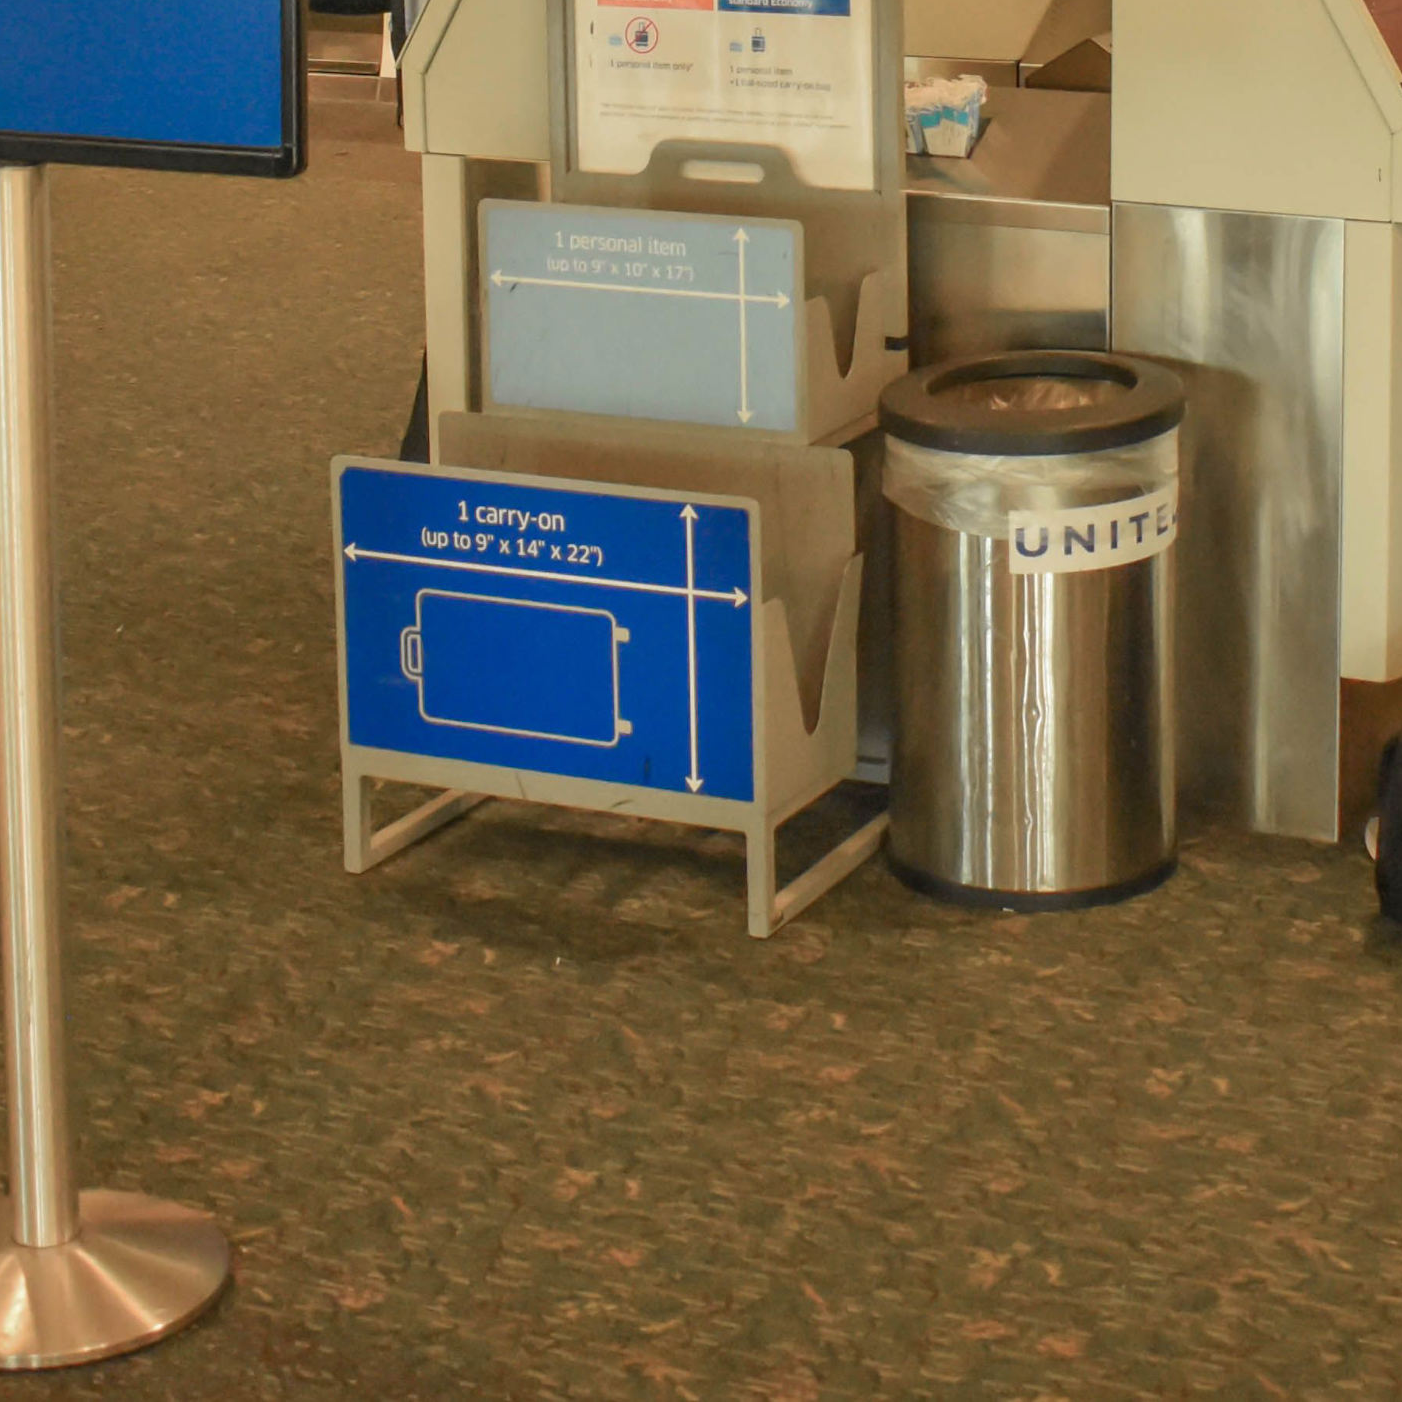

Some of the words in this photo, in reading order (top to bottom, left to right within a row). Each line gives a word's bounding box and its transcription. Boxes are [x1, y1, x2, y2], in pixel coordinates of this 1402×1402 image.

[555, 230, 564, 248] 1
[570, 234, 642, 253] personal
[648, 237, 687, 256] item
[547, 255, 569, 272] (up
[573, 257, 587, 273] to
[610, 264, 619, 275] x
[625, 262, 648, 277] 10"
[652, 267, 661, 278] x
[458, 500, 469, 522] 1
[475, 506, 565, 532] carry-on
[1015, 503, 1176, 557] UNITE
[421, 526, 448, 549] (up
[453, 531, 471, 550] to
[476, 533, 494, 551] 9"
[499, 539, 510, 554] x
[516, 538, 545, 558] 14"
[550, 545, 562, 560] x
[567, 544, 603, 567] 22")
